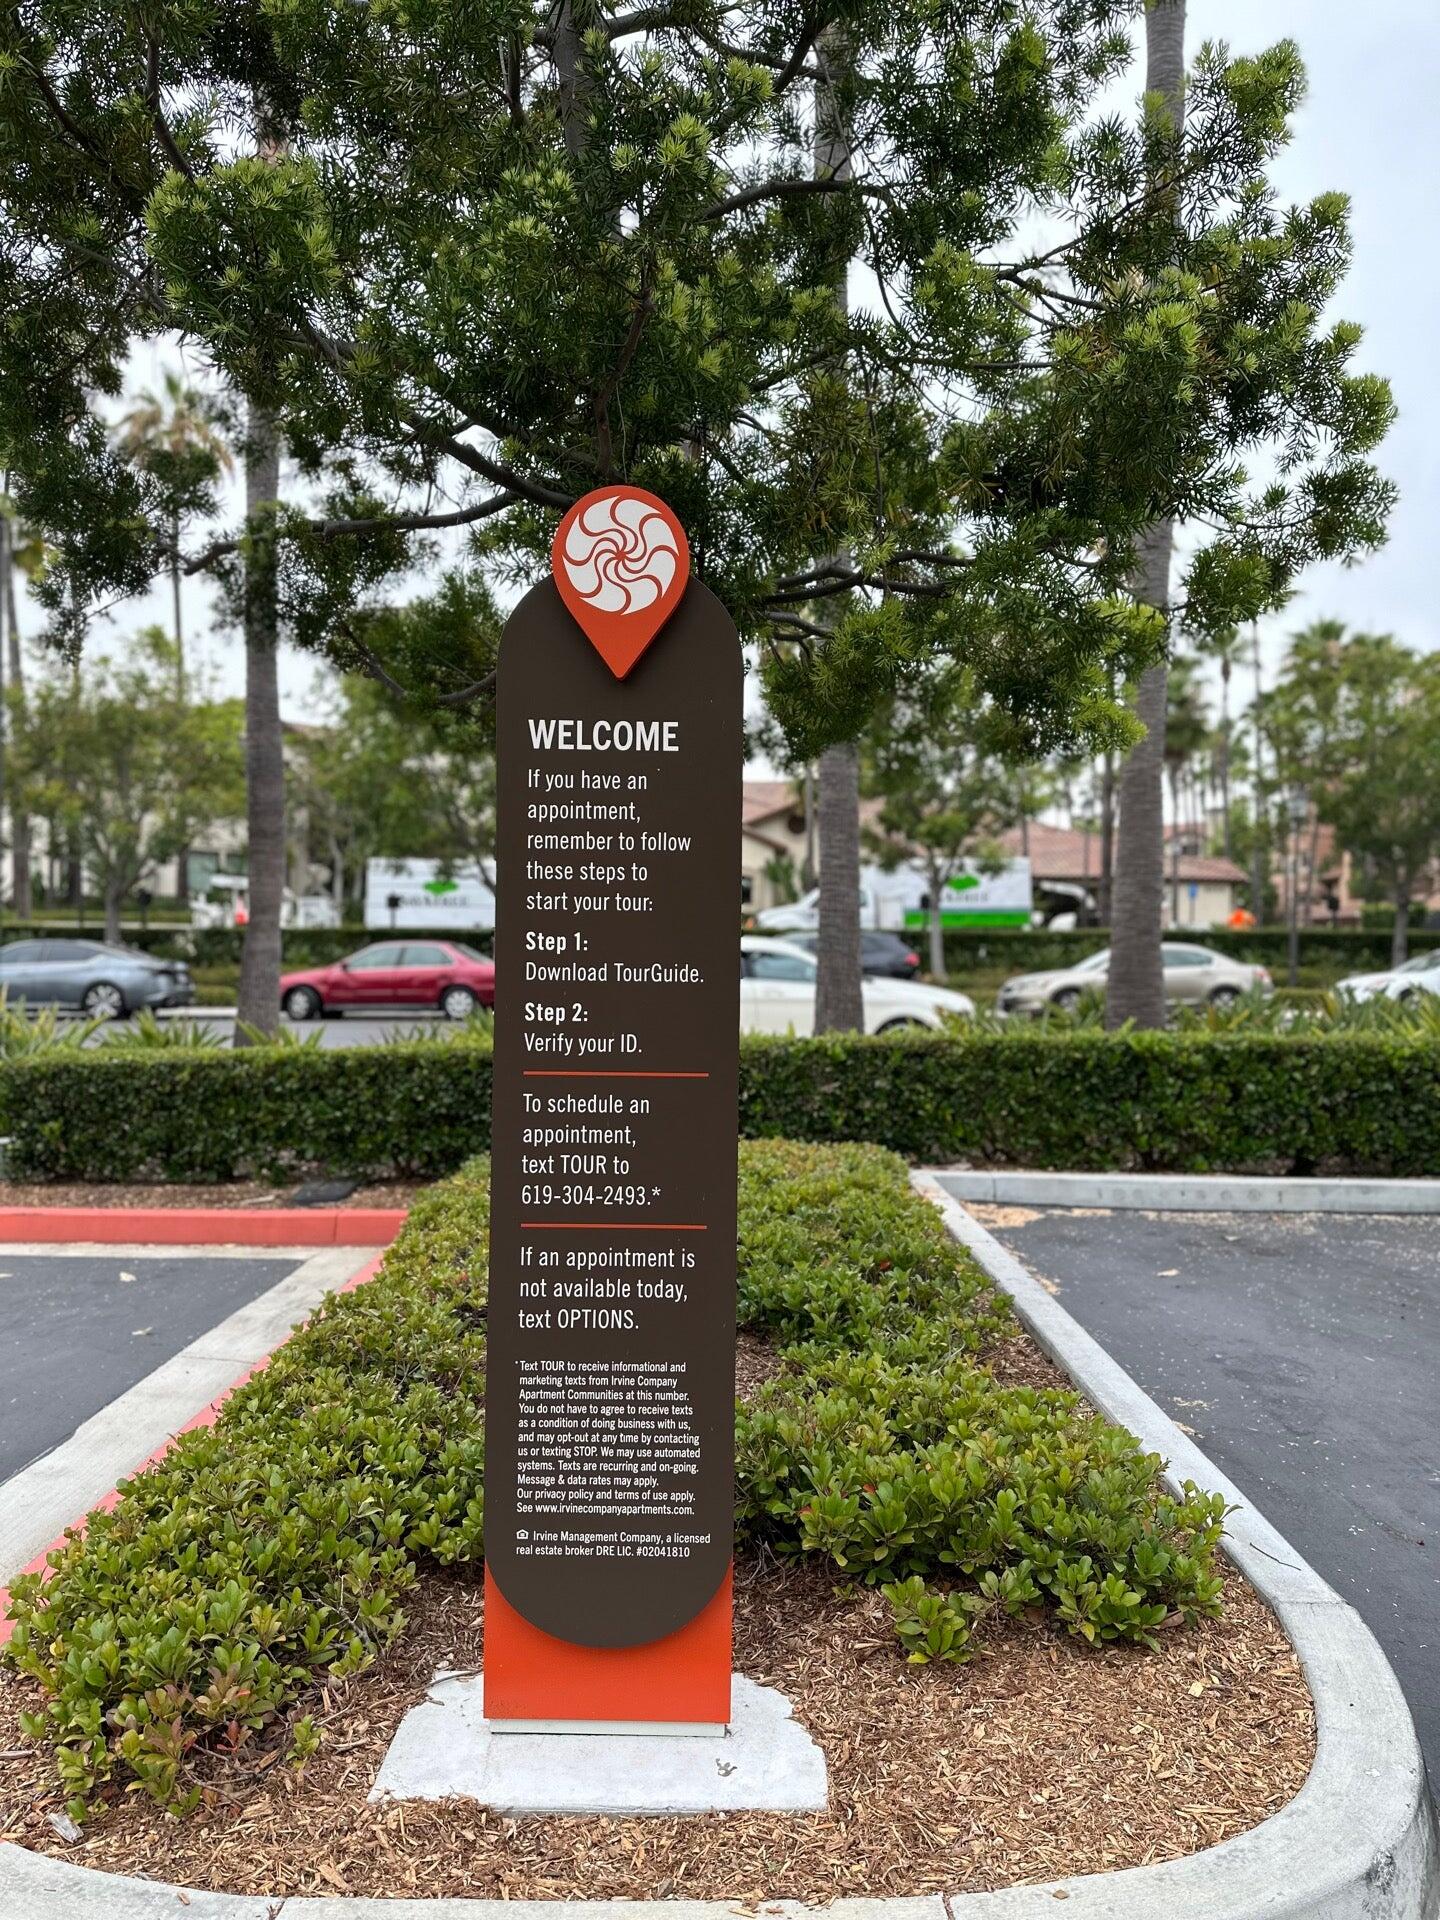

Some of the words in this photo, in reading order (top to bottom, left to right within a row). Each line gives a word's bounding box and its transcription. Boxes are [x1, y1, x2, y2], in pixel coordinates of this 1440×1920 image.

[528, 718, 679, 752] WELCOME
[528, 768, 541, 788] If
[545, 773, 574, 793] you
[581, 769, 621, 790] have
[627, 775, 647, 790] an
[527, 800, 641, 824] appointment,
[527, 830, 614, 851] remember
[618, 831, 635, 851] to
[640, 831, 692, 852] follow
[526, 860, 573, 880] these
[579, 861, 626, 885] steps
[631, 862, 648, 881] to
[526, 891, 568, 911] start
[573, 896, 610, 915] your
[614, 892, 653, 912] tour:
[525, 931, 567, 955] Step
[574, 931, 588, 951] 1:
[526, 961, 608, 982] Download
[613, 962, 704, 983] TourGuide.
[524, 1001, 566, 1026] Step
[571, 1002, 588, 1022] 2:
[524, 1032, 574, 1056] Verify
[578, 1038, 615, 1057] your
[620, 1033, 642, 1053] ID.
[522, 1093, 541, 1113] To
[547, 1093, 623, 1114] schedule
[629, 1099, 650, 1114] an
[522, 1124, 636, 1148] appointment,
[521, 1154, 555, 1174] text
[560, 1154, 607, 1175] TOUR
[612, 1155, 630, 1175] to
[520, 1246, 533, 1266] If
[538, 1251, 559, 1267] an
[566, 1247, 675, 1271] appointment
[681, 1247, 695, 1268] is
[520, 1278, 547, 1298] not
[553, 1277, 631, 1298] available
[636, 1278, 688, 1303] today,
[518, 1309, 552, 1329] text
[557, 1308, 639, 1330] OPTIONS.
[540, 1360, 565, 1372] TOUR
[566, 1360, 577, 1372] to
[578, 1360, 610, 1372] receive
[611, 1360, 668, 1373] informational
[669, 1361, 686, 1373] and
[519, 1374, 563, 1388] marketing
[564, 1375, 587, 1386] texts
[588, 1374, 609, 1386] from
[611, 1374, 636, 1387] Irvine
[637, 1375, 678, 1389] Company
[518, 1388, 566, 1402] Apartment
[567, 1388, 624, 1401] Communities
[625, 1389, 635, 1401] at
[636, 1389, 653, 1401] this
[654, 1390, 690, 1401] number.
[518, 1402, 535, 1414] You
[536, 1402, 548, 1414] do
[550, 1403, 565, 1414] not
[566, 1403, 588, 1414] have
[589, 1403, 599, 1415] to
[600, 1405, 625, 1417] agree
[626, 1403, 636, 1415] to
[638, 1404, 670, 1415] receive
[671, 1404, 694, 1416] texts
[518, 1419, 529, 1428] as
[530, 1419, 536, 1428] a
[538, 1416, 579, 1429] condition
[580, 1417, 590, 1429] of
[591, 1417, 616, 1431] doing
[617, 1417, 656, 1430] business
[657, 1418, 676, 1430] with
[678, 1421, 691, 1431] us,
[517, 1431, 535, 1442] and
[536, 1433, 555, 1445] may
[556, 1431, 589, 1445] opt-out
[590, 1432, 600, 1443] at
[601, 1434, 618, 1445] any
[619, 1432, 639, 1444] time
[641, 1432, 652, 1446] by
[653, 1432, 700, 1447] contacting
[517, 1447, 529, 1457] us
[530, 1447, 540, 1457] or
[541, 1445, 572, 1459] texting
[573, 1445, 598, 1457] STOP.
[600, 1446, 615, 1457] We
[616, 1448, 635, 1460] may
[636, 1448, 652, 1458] use
[654, 1447, 701, 1459] automated
[517, 1460, 556, 1473] systems.
[557, 1459, 581, 1471] Texts
[582, 1462, 598, 1471] are
[599, 1460, 639, 1474] recurring
[640, 1460, 657, 1472] and
[658, 1461, 699, 1475] on-going.
[517, 1473, 556, 1487] Message
[557, 1474, 565, 1485] &
[567, 1474, 587, 1486] data
[589, 1474, 612, 1486] rates
[613, 1477, 632, 1488] may
[633, 1475, 659, 1489] apply.
[516, 1487, 533, 1499] Our
[534, 1487, 567, 1502] privacy
[568, 1488, 594, 1502] policy
[595, 1488, 612, 1500] and
[614, 1489, 640, 1501] terms
[641, 1489, 651, 1501] of
[652, 1492, 669, 1501] use
[670, 1489, 696, 1503] apply.
[516, 1501, 533, 1513] See
[534, 1502, 695, 1516] www.irvinecompanyapartments.com.
[533, 1530, 559, 1541] Irvine
[560, 1530, 618, 1544] Management
[619, 1531, 664, 1545] Company,
[666, 1534, 672, 1543] a
[673, 1532, 711, 1544] licensed
[516, 1544, 533, 1555] real
[534, 1544, 563, 1556] estate
[564, 1544, 595, 1556] broker
[596, 1545, 615, 1557] DRE
[617, 1545, 634, 1557] LIC.
[636, 1545, 690, 1558] #02041810
